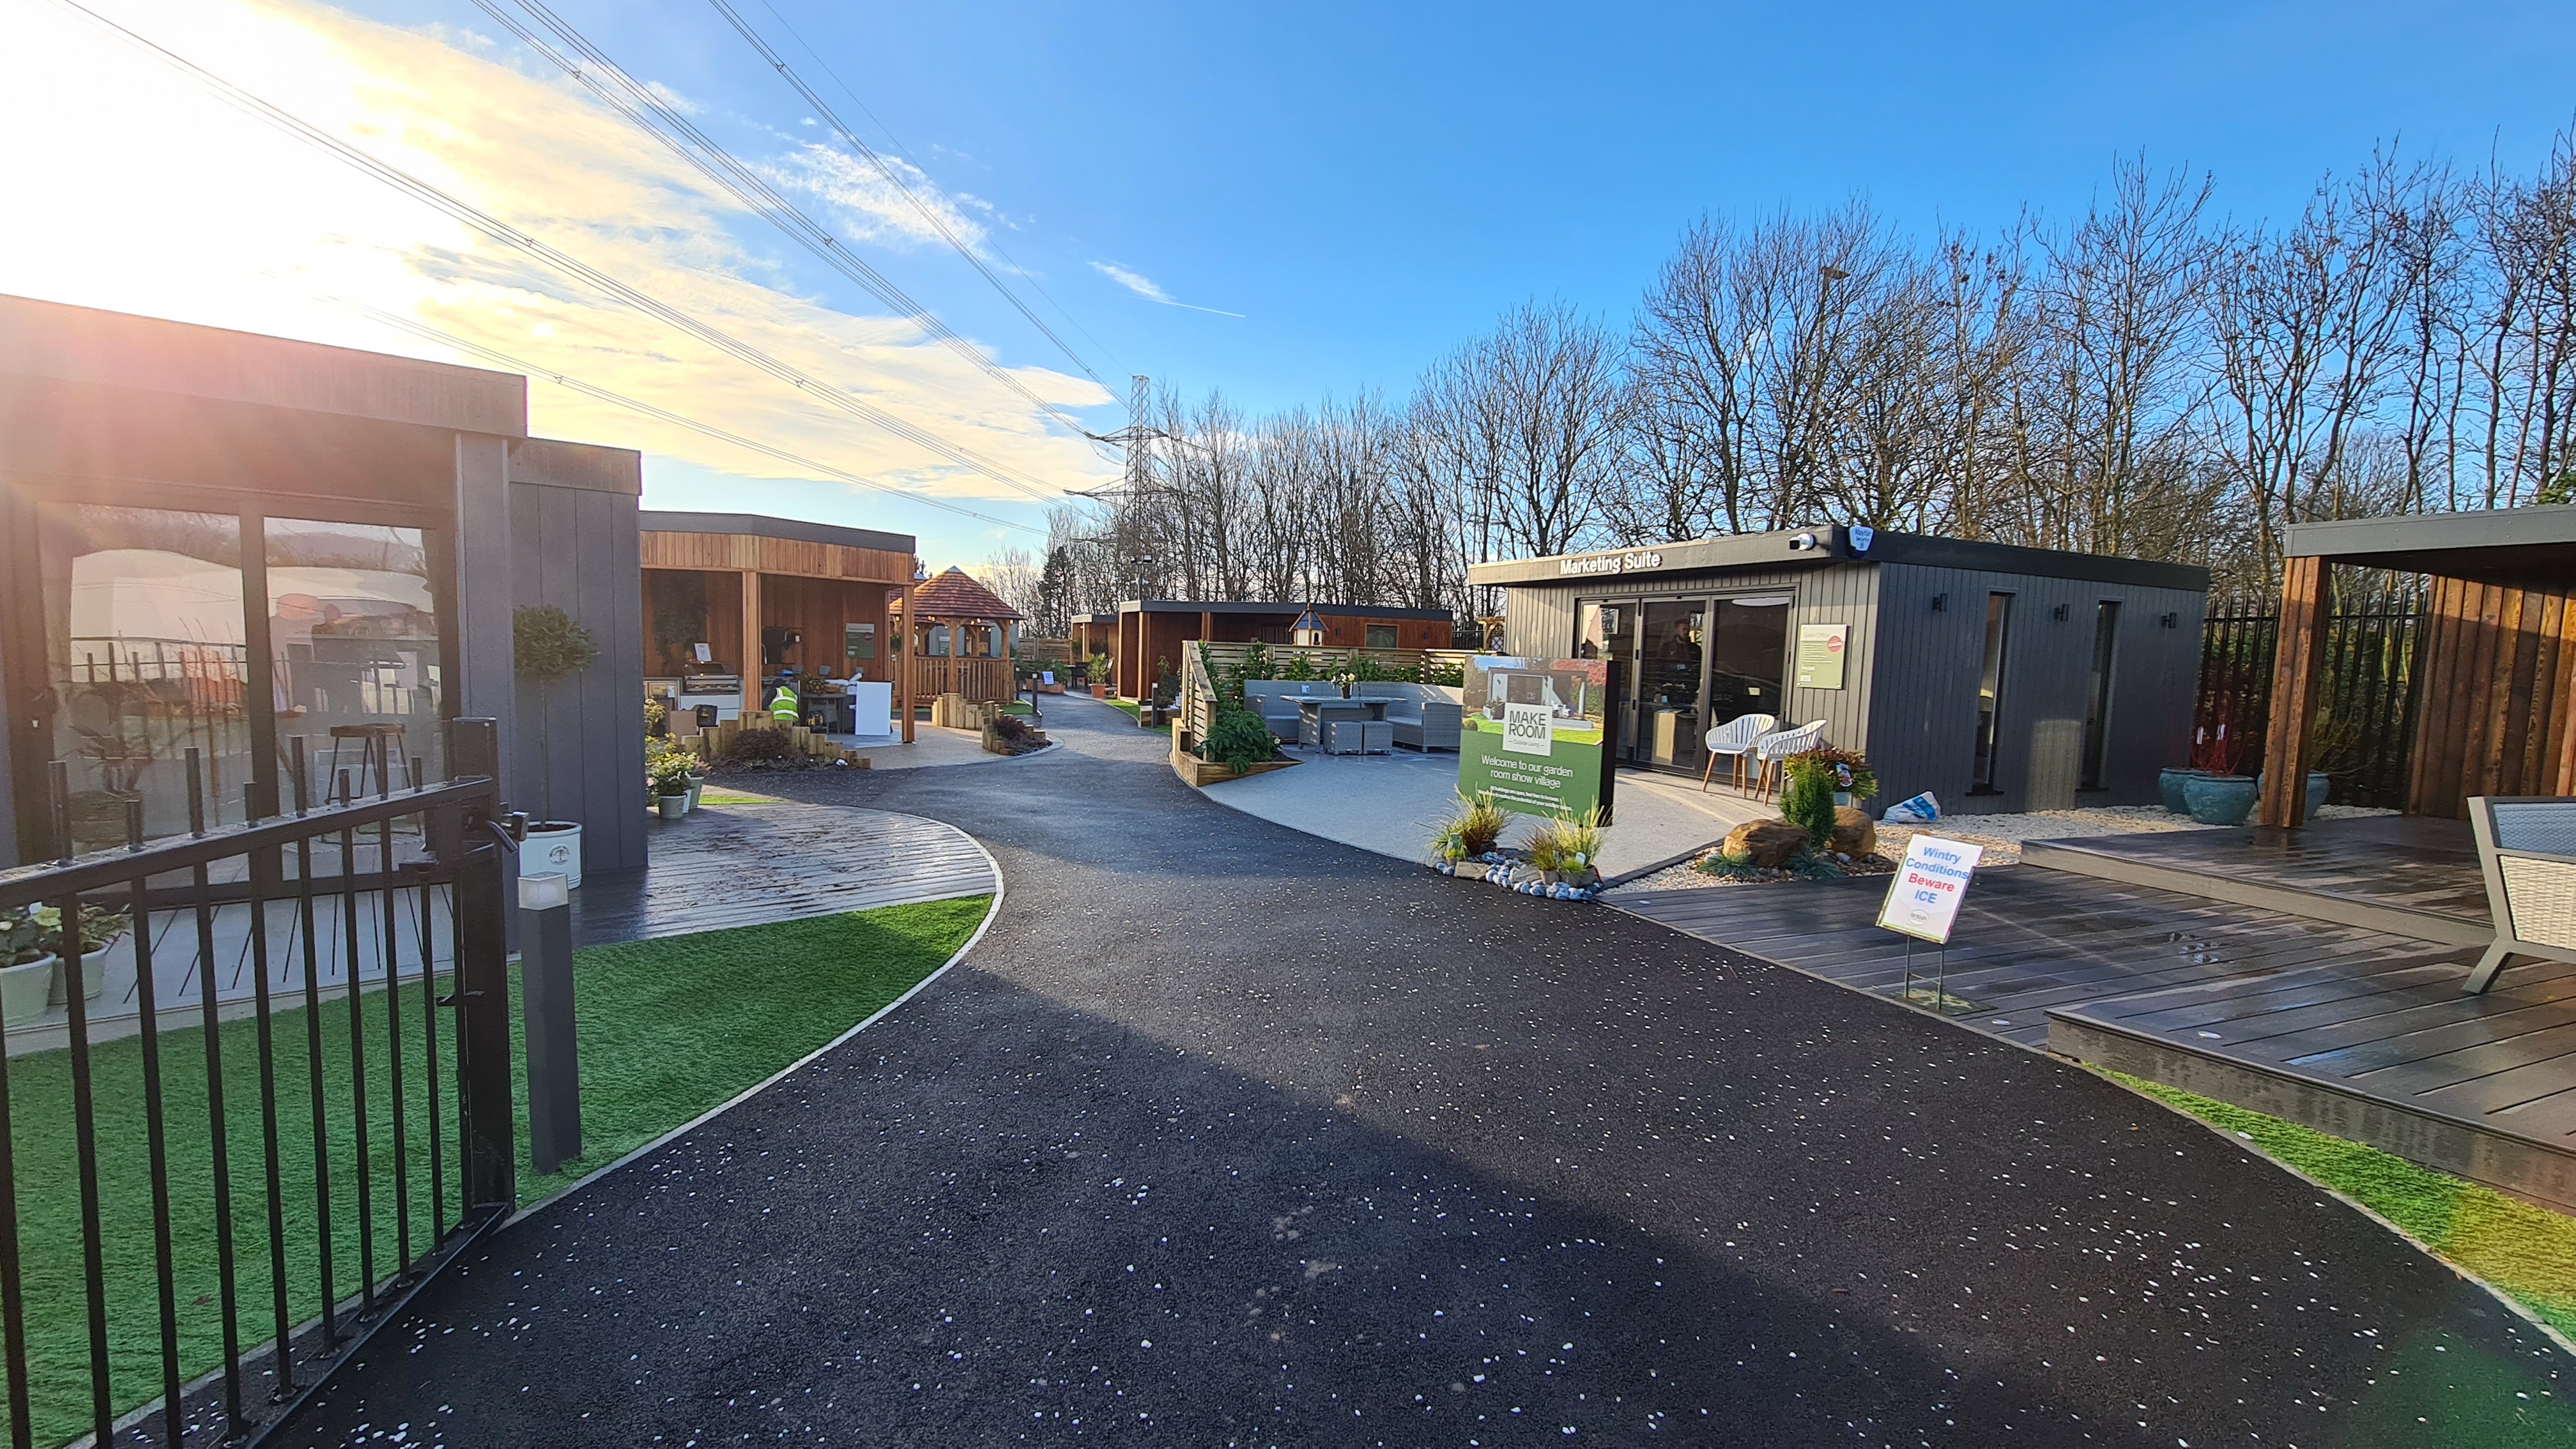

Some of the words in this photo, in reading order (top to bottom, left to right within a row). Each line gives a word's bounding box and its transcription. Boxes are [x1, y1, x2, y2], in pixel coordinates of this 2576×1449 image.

[1560, 556, 1622, 574] Marketing
[1624, 551, 1662, 570] Suite
[1510, 710, 1546, 726] MAKE
[1508, 723, 1545, 739] ROOM
[1481, 755, 1517, 769] Welcome
[1519, 760, 1527, 770] to
[1528, 763, 1542, 772] our
[1543, 765, 1573, 778] garden
[1490, 769, 1510, 779] room
[1512, 772, 1533, 783] show
[1534, 775, 1561, 789] village
[1923, 847, 1961, 864] Wintry
[1906, 858, 1970, 880] Conditions
[1908, 873, 1955, 892] Beware
[1914, 890, 1938, 904] ICE
